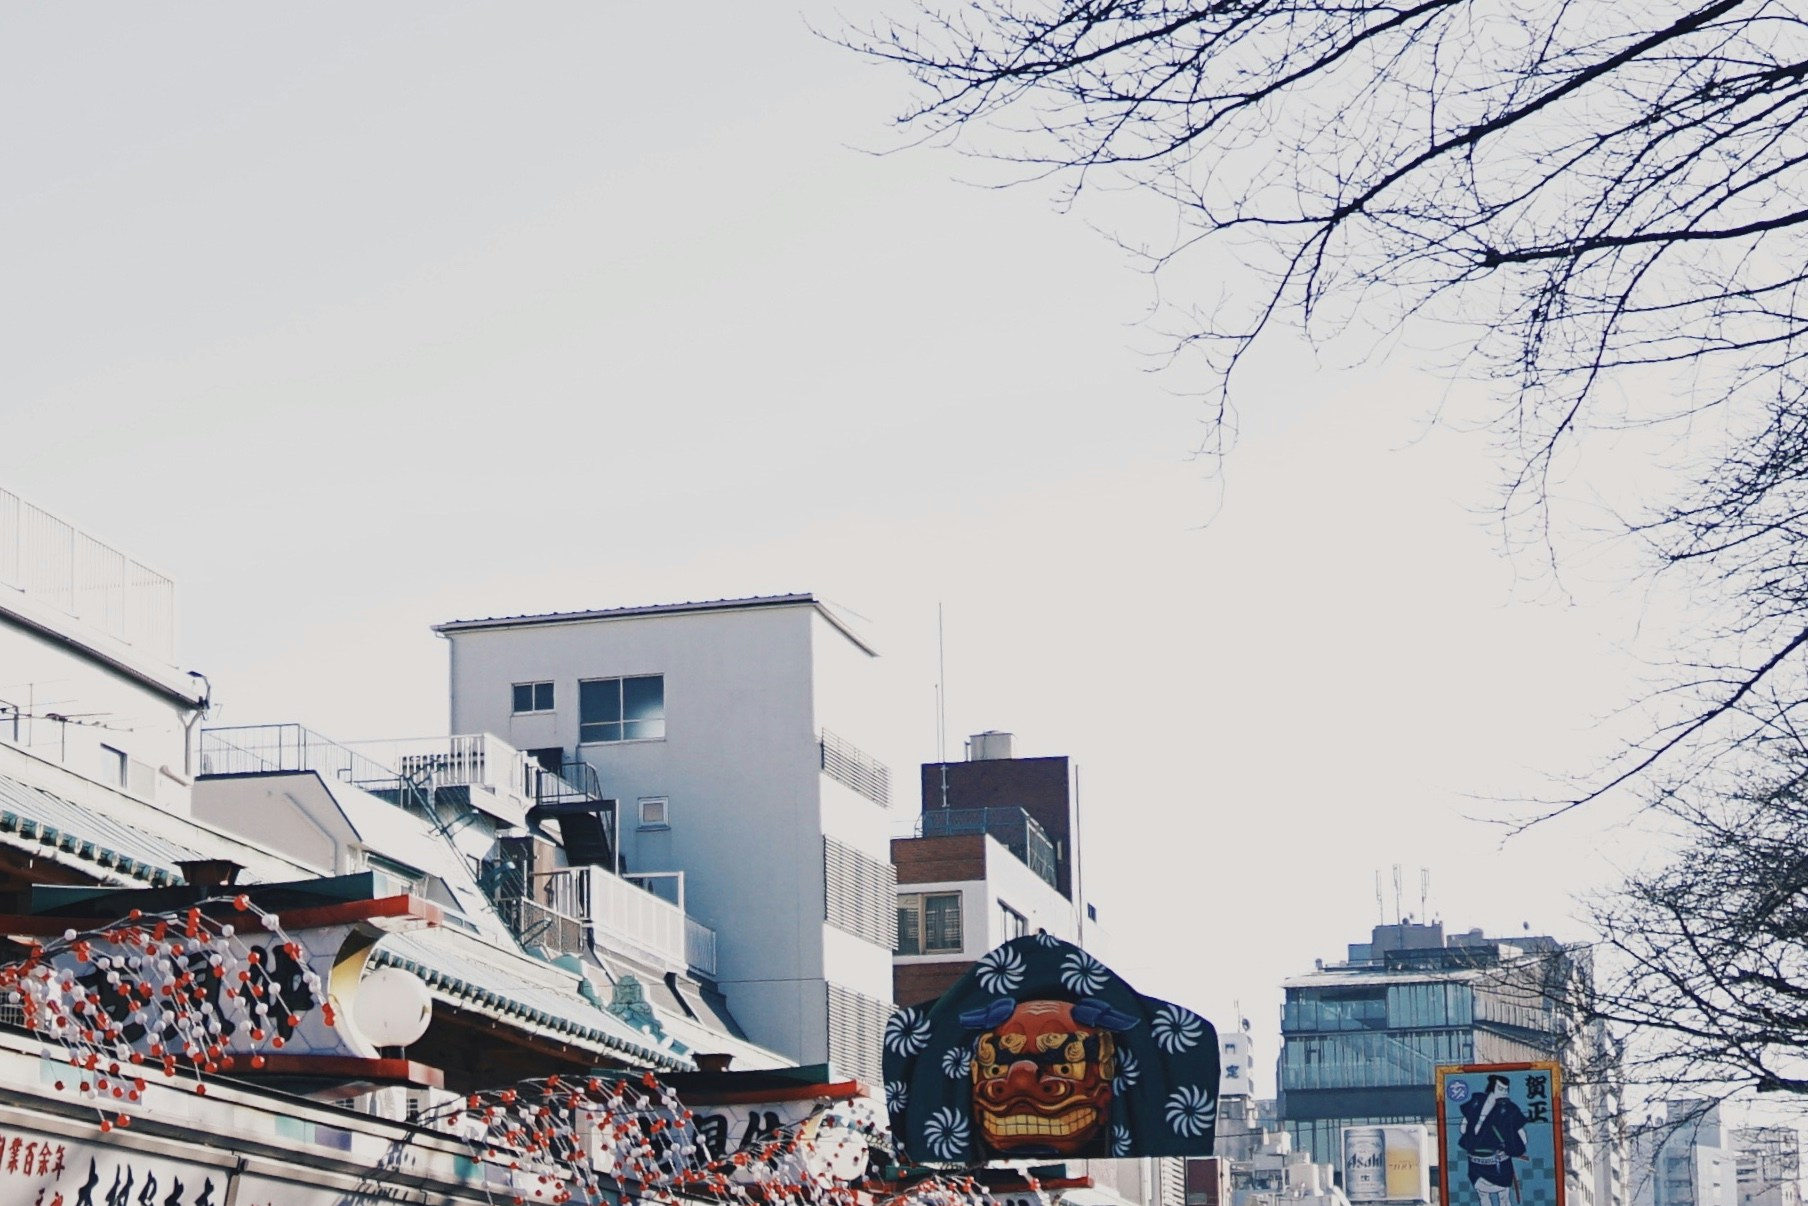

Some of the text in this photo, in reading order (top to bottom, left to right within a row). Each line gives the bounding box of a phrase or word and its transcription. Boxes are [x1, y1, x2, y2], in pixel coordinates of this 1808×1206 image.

[1449, 1081, 1467, 1099] 亥
[1525, 1074, 1549, 1123] 賀正
[1347, 1152, 1383, 1169] Asahi
